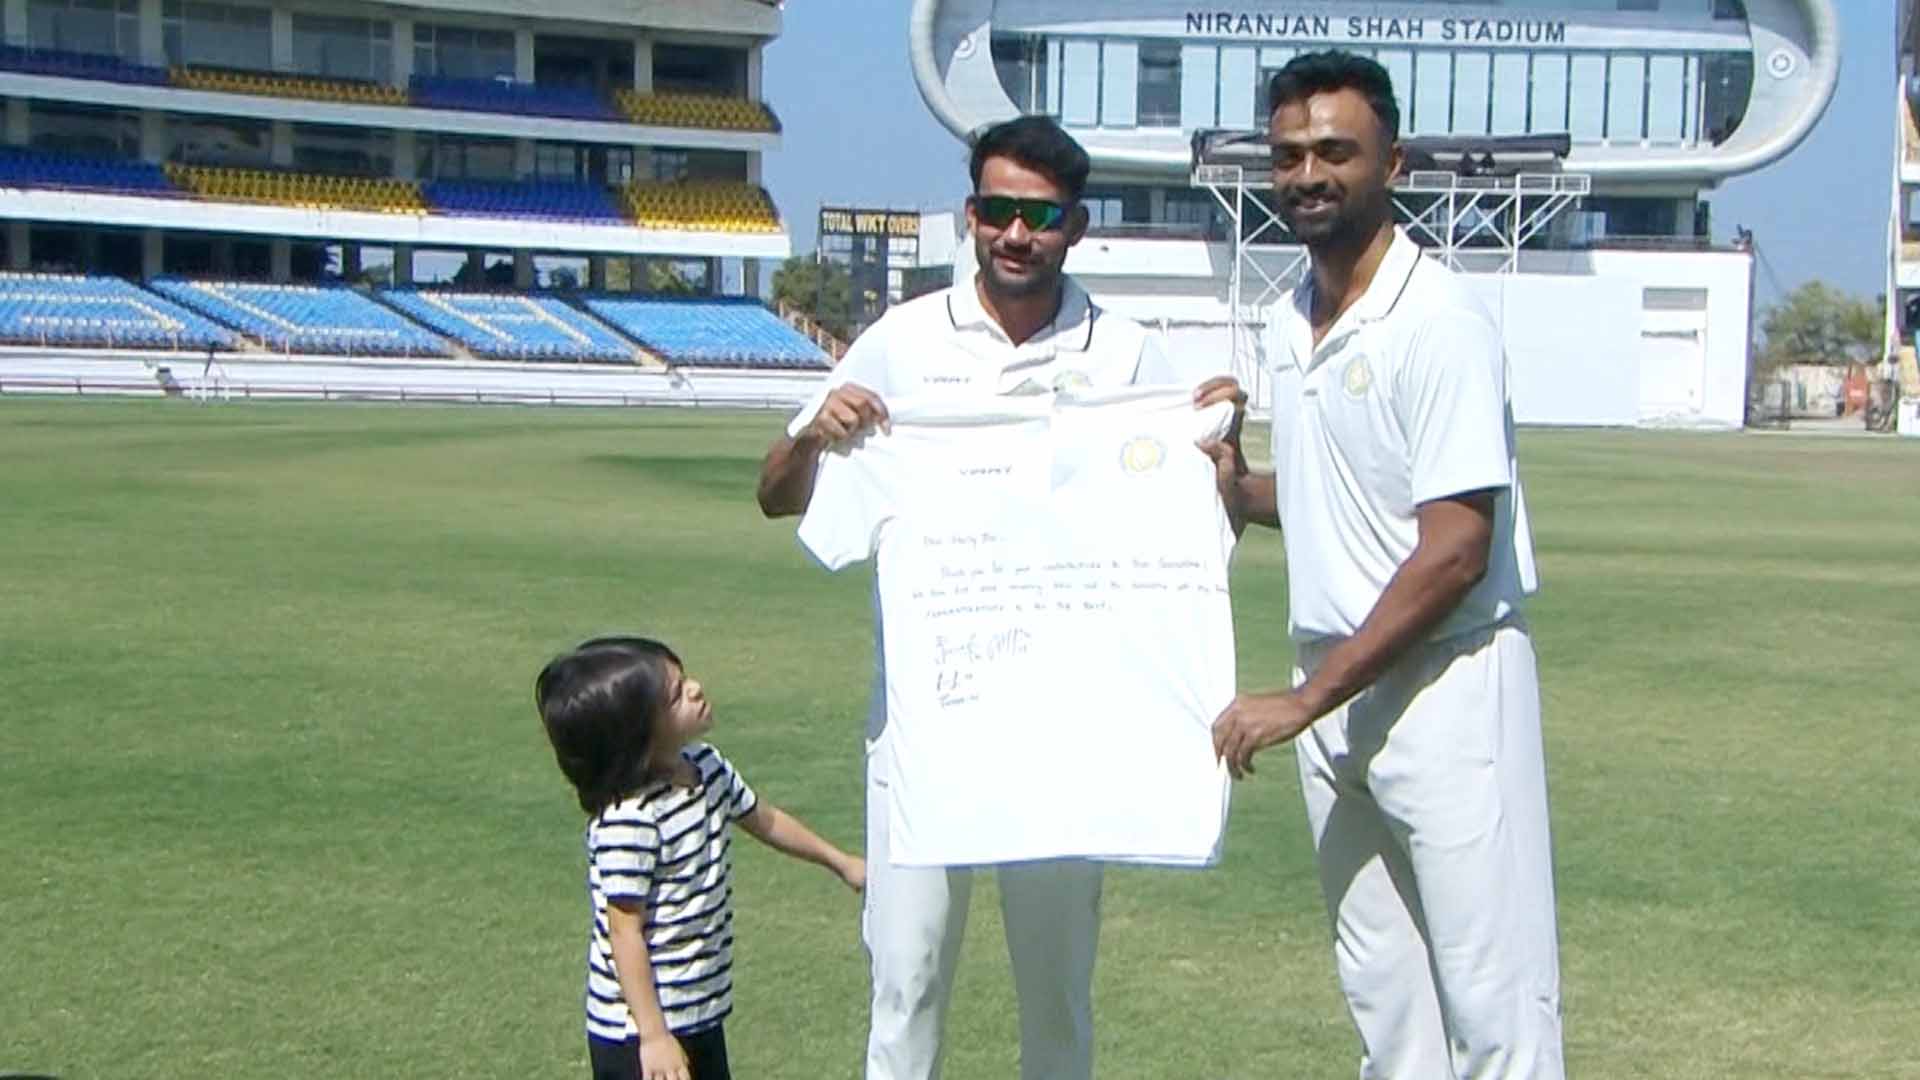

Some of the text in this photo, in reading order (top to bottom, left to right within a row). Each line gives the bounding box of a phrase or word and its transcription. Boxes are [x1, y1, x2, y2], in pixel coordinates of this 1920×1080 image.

[1186, 12, 1566, 43] NIRANJAN SHAH STADIUM
[822, 210, 853, 233] TOTAL
